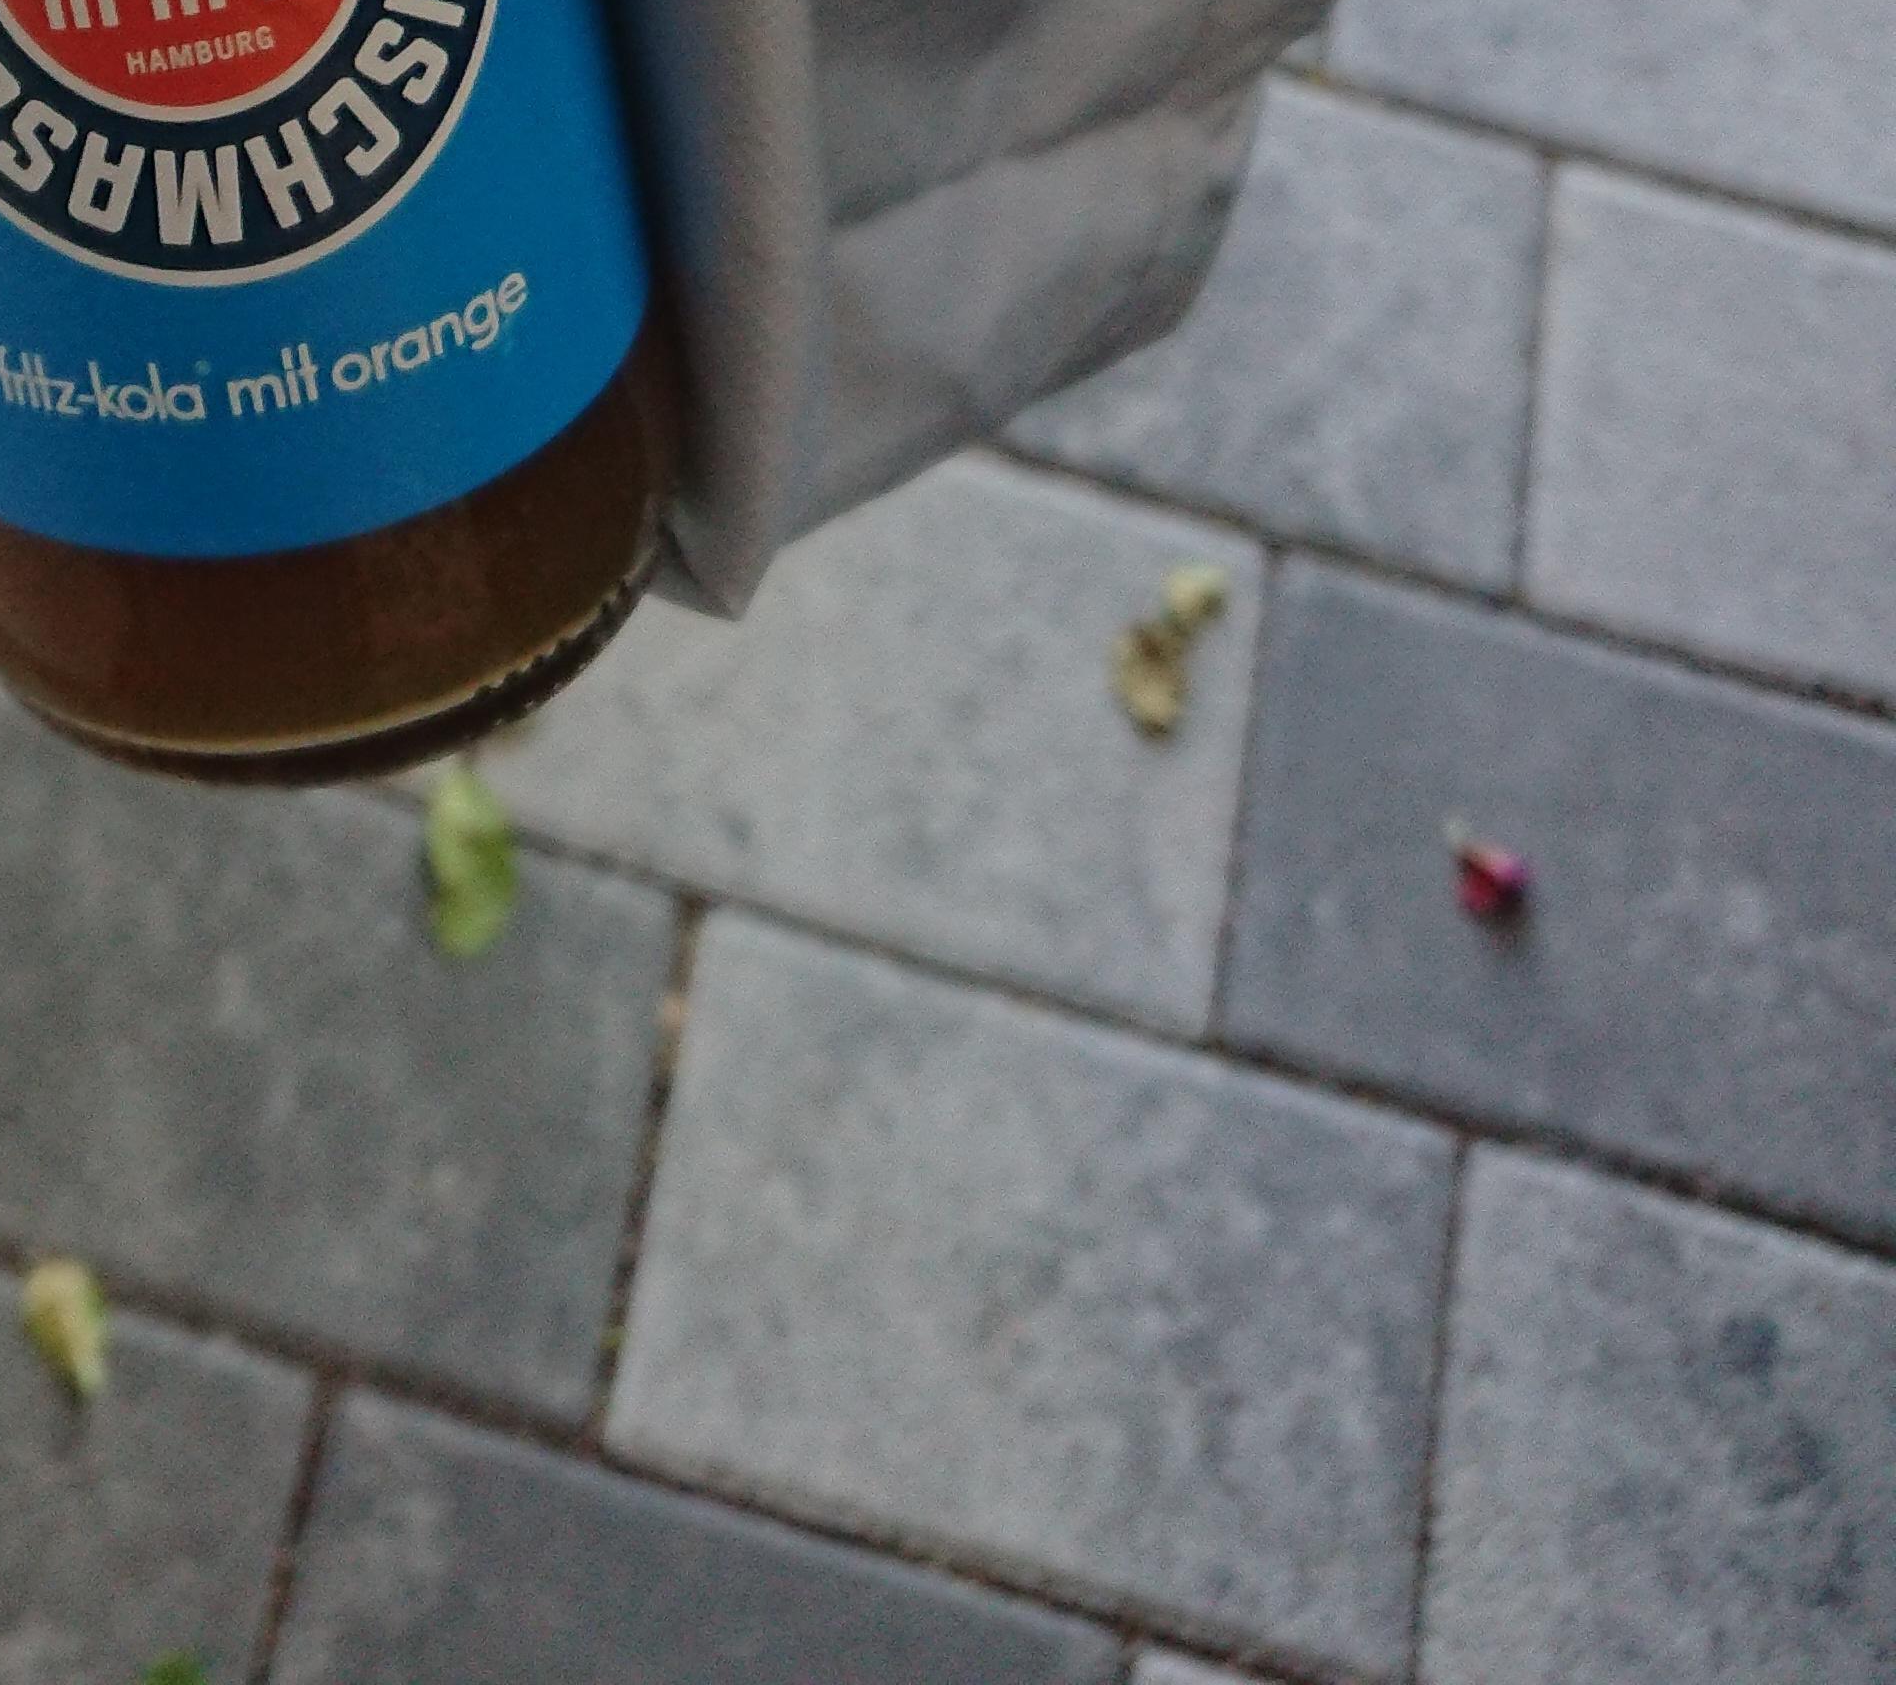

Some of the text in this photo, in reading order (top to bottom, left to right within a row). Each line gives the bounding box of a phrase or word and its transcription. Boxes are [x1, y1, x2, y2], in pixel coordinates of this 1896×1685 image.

[126, 24, 276, 77] HAMBURG
[226, 342, 319, 416] mit
[331, 271, 529, 392] orange
